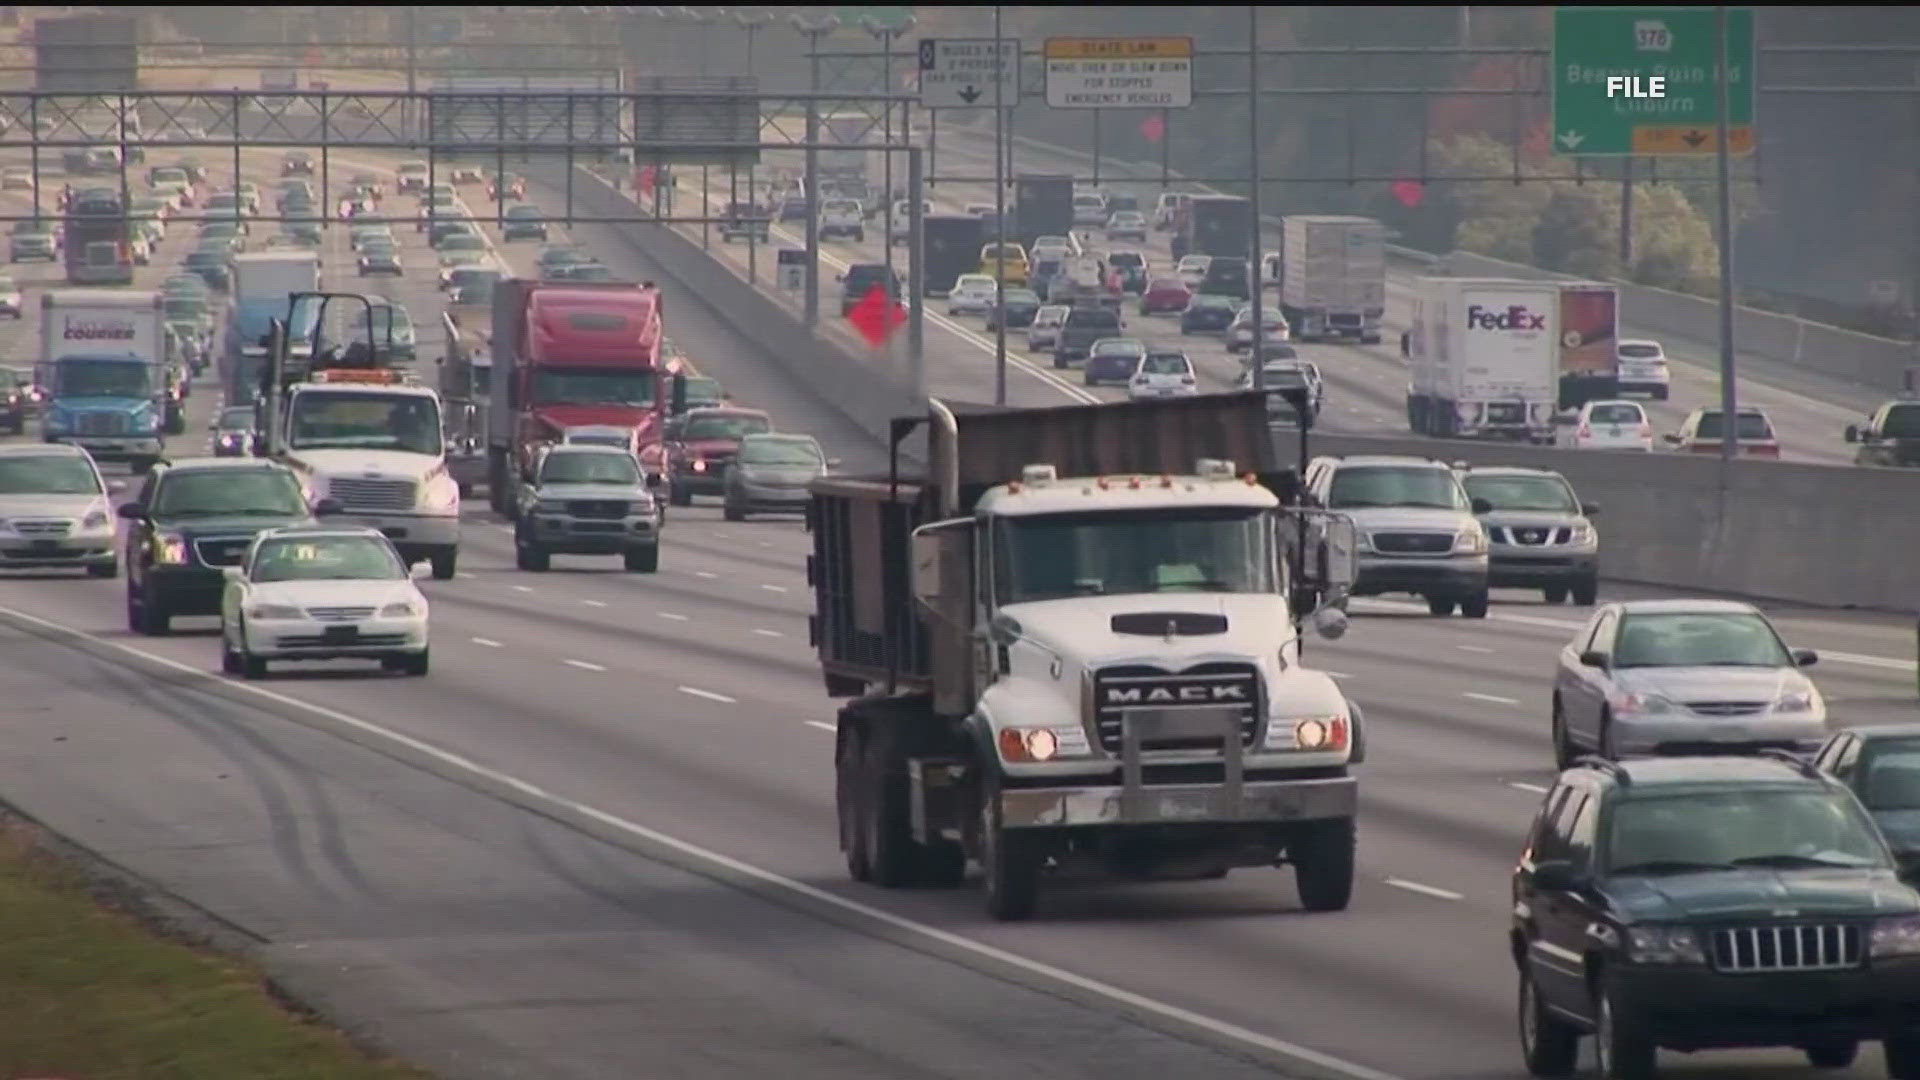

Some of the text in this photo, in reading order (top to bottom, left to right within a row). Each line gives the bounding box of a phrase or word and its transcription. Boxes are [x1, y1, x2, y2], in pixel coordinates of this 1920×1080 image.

[1081, 42, 1156, 53] STATE LAW
[1050, 62, 1076, 73] MOVE
[1082, 62, 1106, 73] OVER
[1131, 62, 1155, 73] SLOW
[1159, 62, 1188, 73] DOWN
[1653, 64, 1705, 83] Ruin
[1084, 77, 1153, 88] FOR STOPPED
[1065, 93, 1172, 104] EMERGENCY VEHICLES
[1468, 305, 1544, 330] FedEx
[63, 328, 136, 340] COURIER
[1107, 685, 1245, 702] MACK
